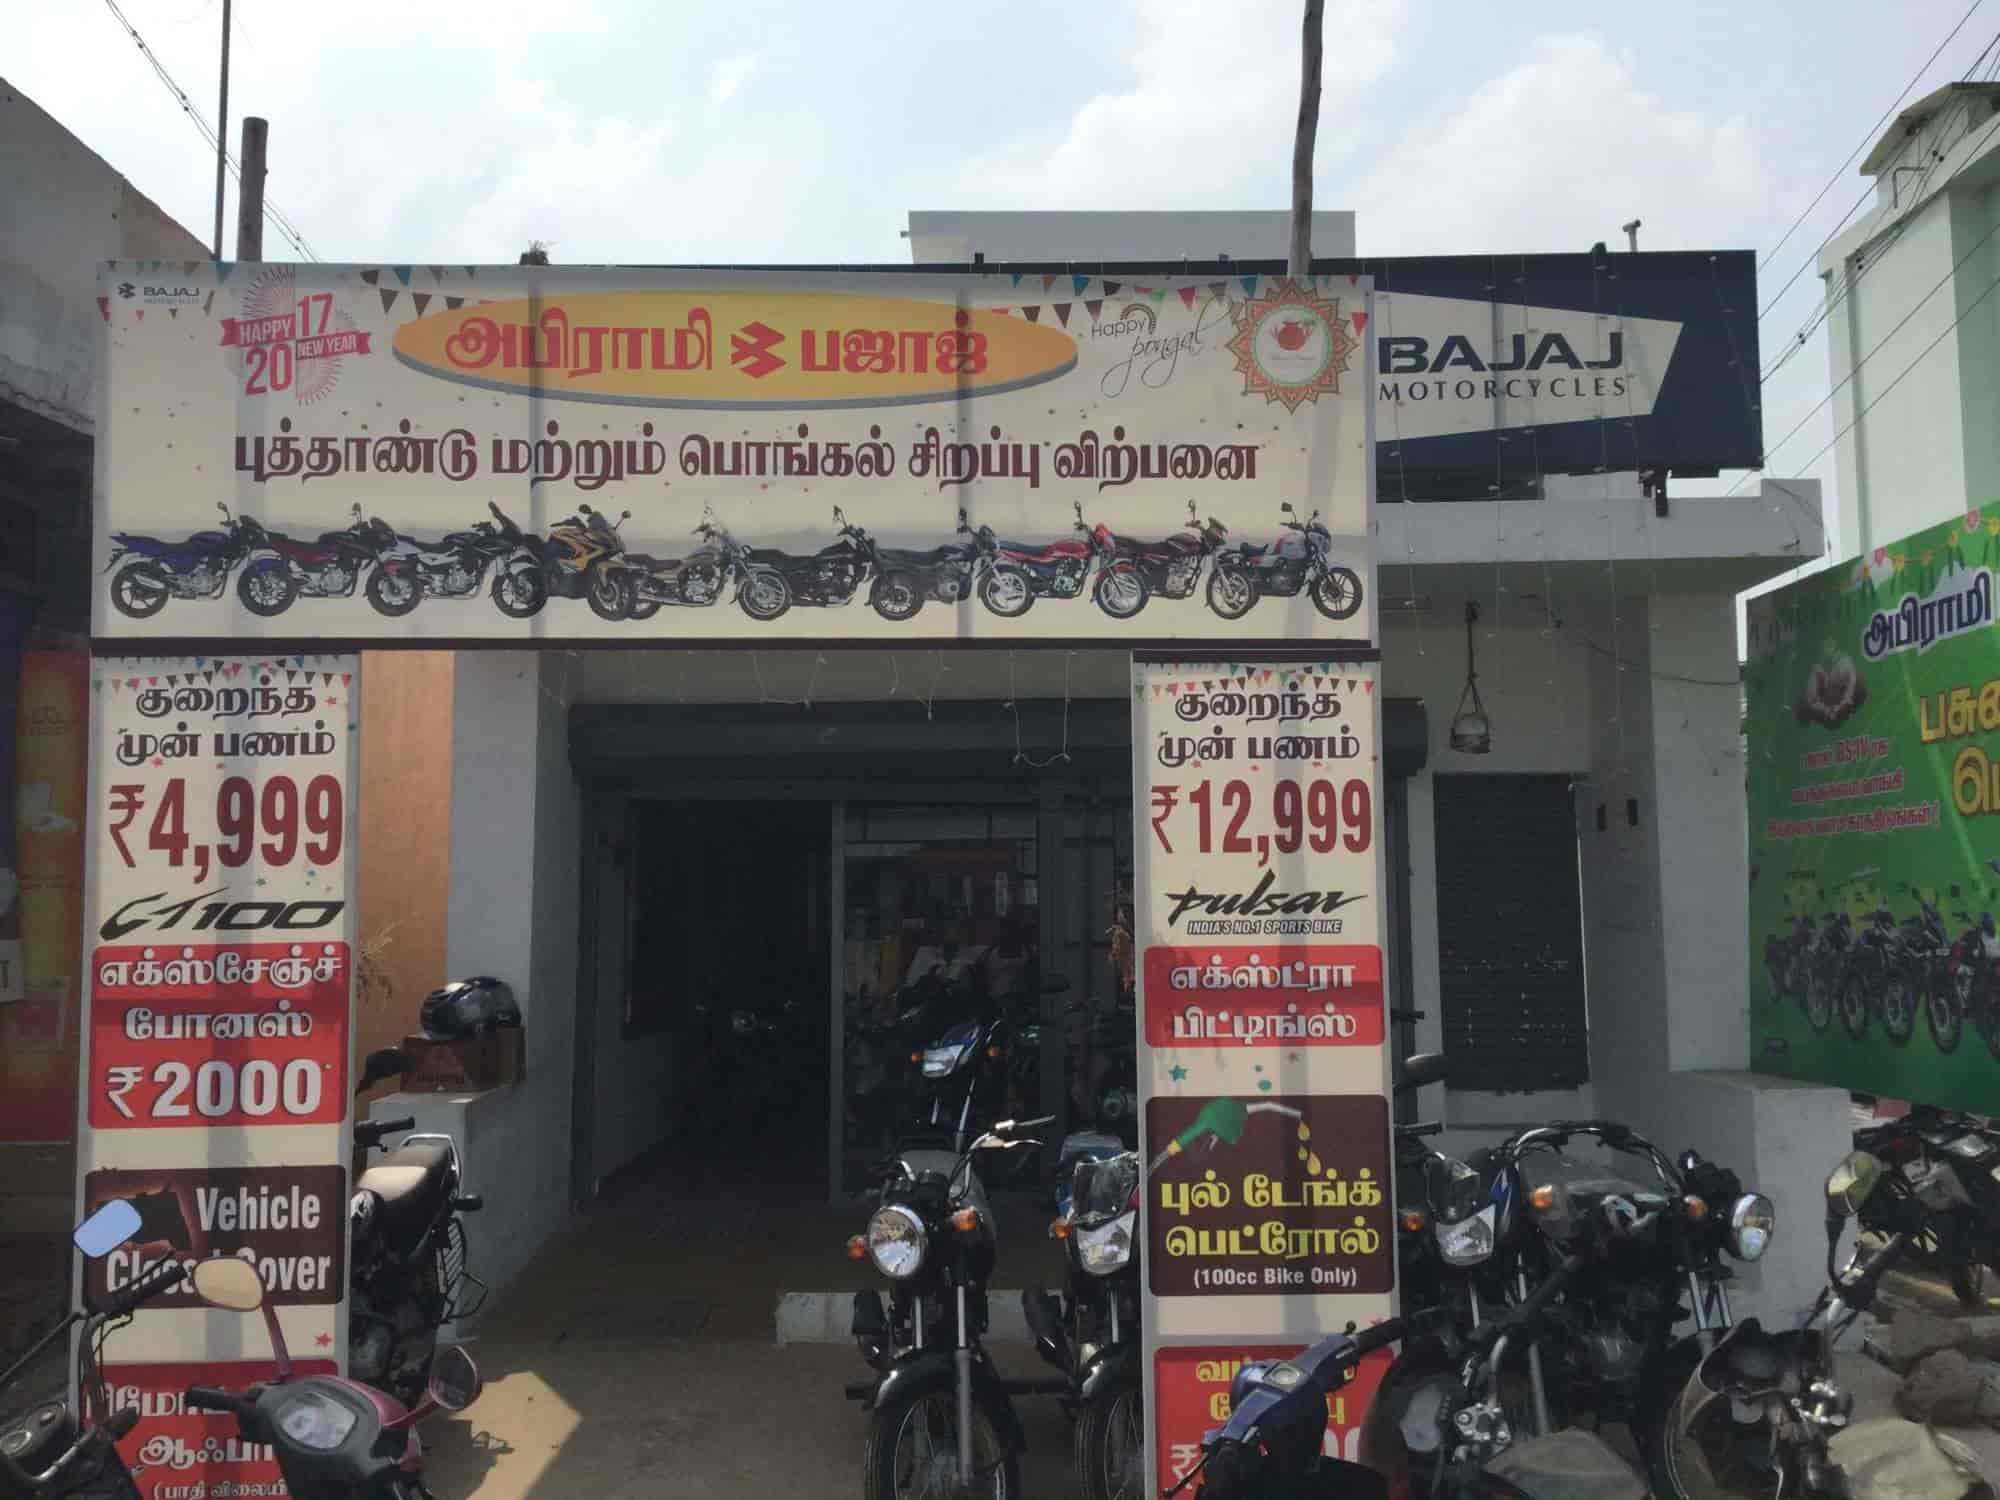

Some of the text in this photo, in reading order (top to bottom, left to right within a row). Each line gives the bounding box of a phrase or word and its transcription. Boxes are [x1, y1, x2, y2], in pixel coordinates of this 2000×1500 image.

[144, 286, 200, 297] BAJAJ
[240, 319, 292, 345] HAPPY
[297, 293, 333, 337] 17
[1091, 317, 1146, 338] Happy
[298, 334, 356, 358] NEW YEAR
[445, 307, 988, 378] அபிராமி பஜாஜ்
[1378, 332, 1623, 374] BAJAJ
[245, 345, 292, 396] 20
[1379, 377, 1626, 401] MOTORCYCLES
[234, 417, 1259, 492] புத்தாண்டு மற்றும் பொங்கல் சிறப்பு விற்பனை
[1864, 571, 1991, 656] அபிராமி
[136, 675, 317, 720] குறைந்த
[1175, 681, 1342, 725] குறைந்த
[116, 719, 336, 766] முன் பணம்
[1158, 724, 1361, 768] முன் பணம்
[1187, 919, 1232, 935] INDIA'S
[1263, 919, 1312, 934] SPORTS
[1312, 919, 1342, 934] BIKE
[100, 944, 343, 989] எக்ஸ்சேஞ்ச்
[1170, 953, 1356, 992] எக்ஸ்ட்ரா
[125, 999, 313, 1040] போனஸ்
[196, 1186, 321, 1232] Vehicle
[1161, 1168, 1382, 1215] புல் டேங்க்
[1165, 1216, 1380, 1260] பெட்ரோல்
[1193, 1267, 1357, 1288] (100cc Bike Only)
